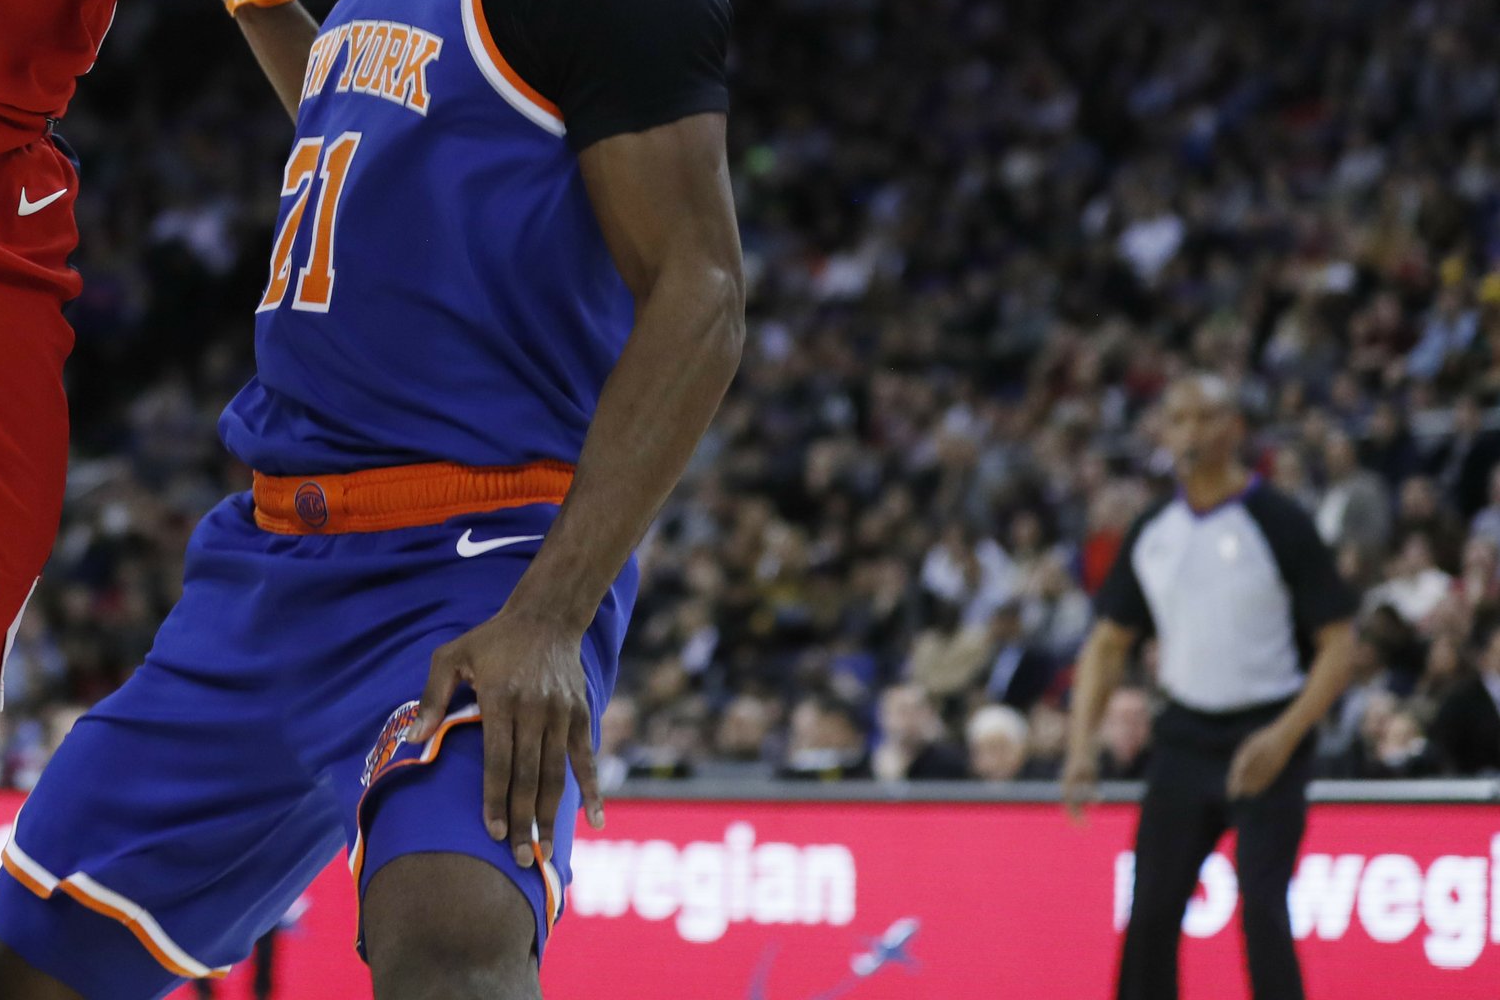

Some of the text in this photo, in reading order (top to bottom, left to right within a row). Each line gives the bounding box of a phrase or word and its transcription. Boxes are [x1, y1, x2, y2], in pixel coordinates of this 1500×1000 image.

[335, 19, 443, 117] YORK
[255, 131, 362, 313] 21
[569, 821, 857, 942] wegian
